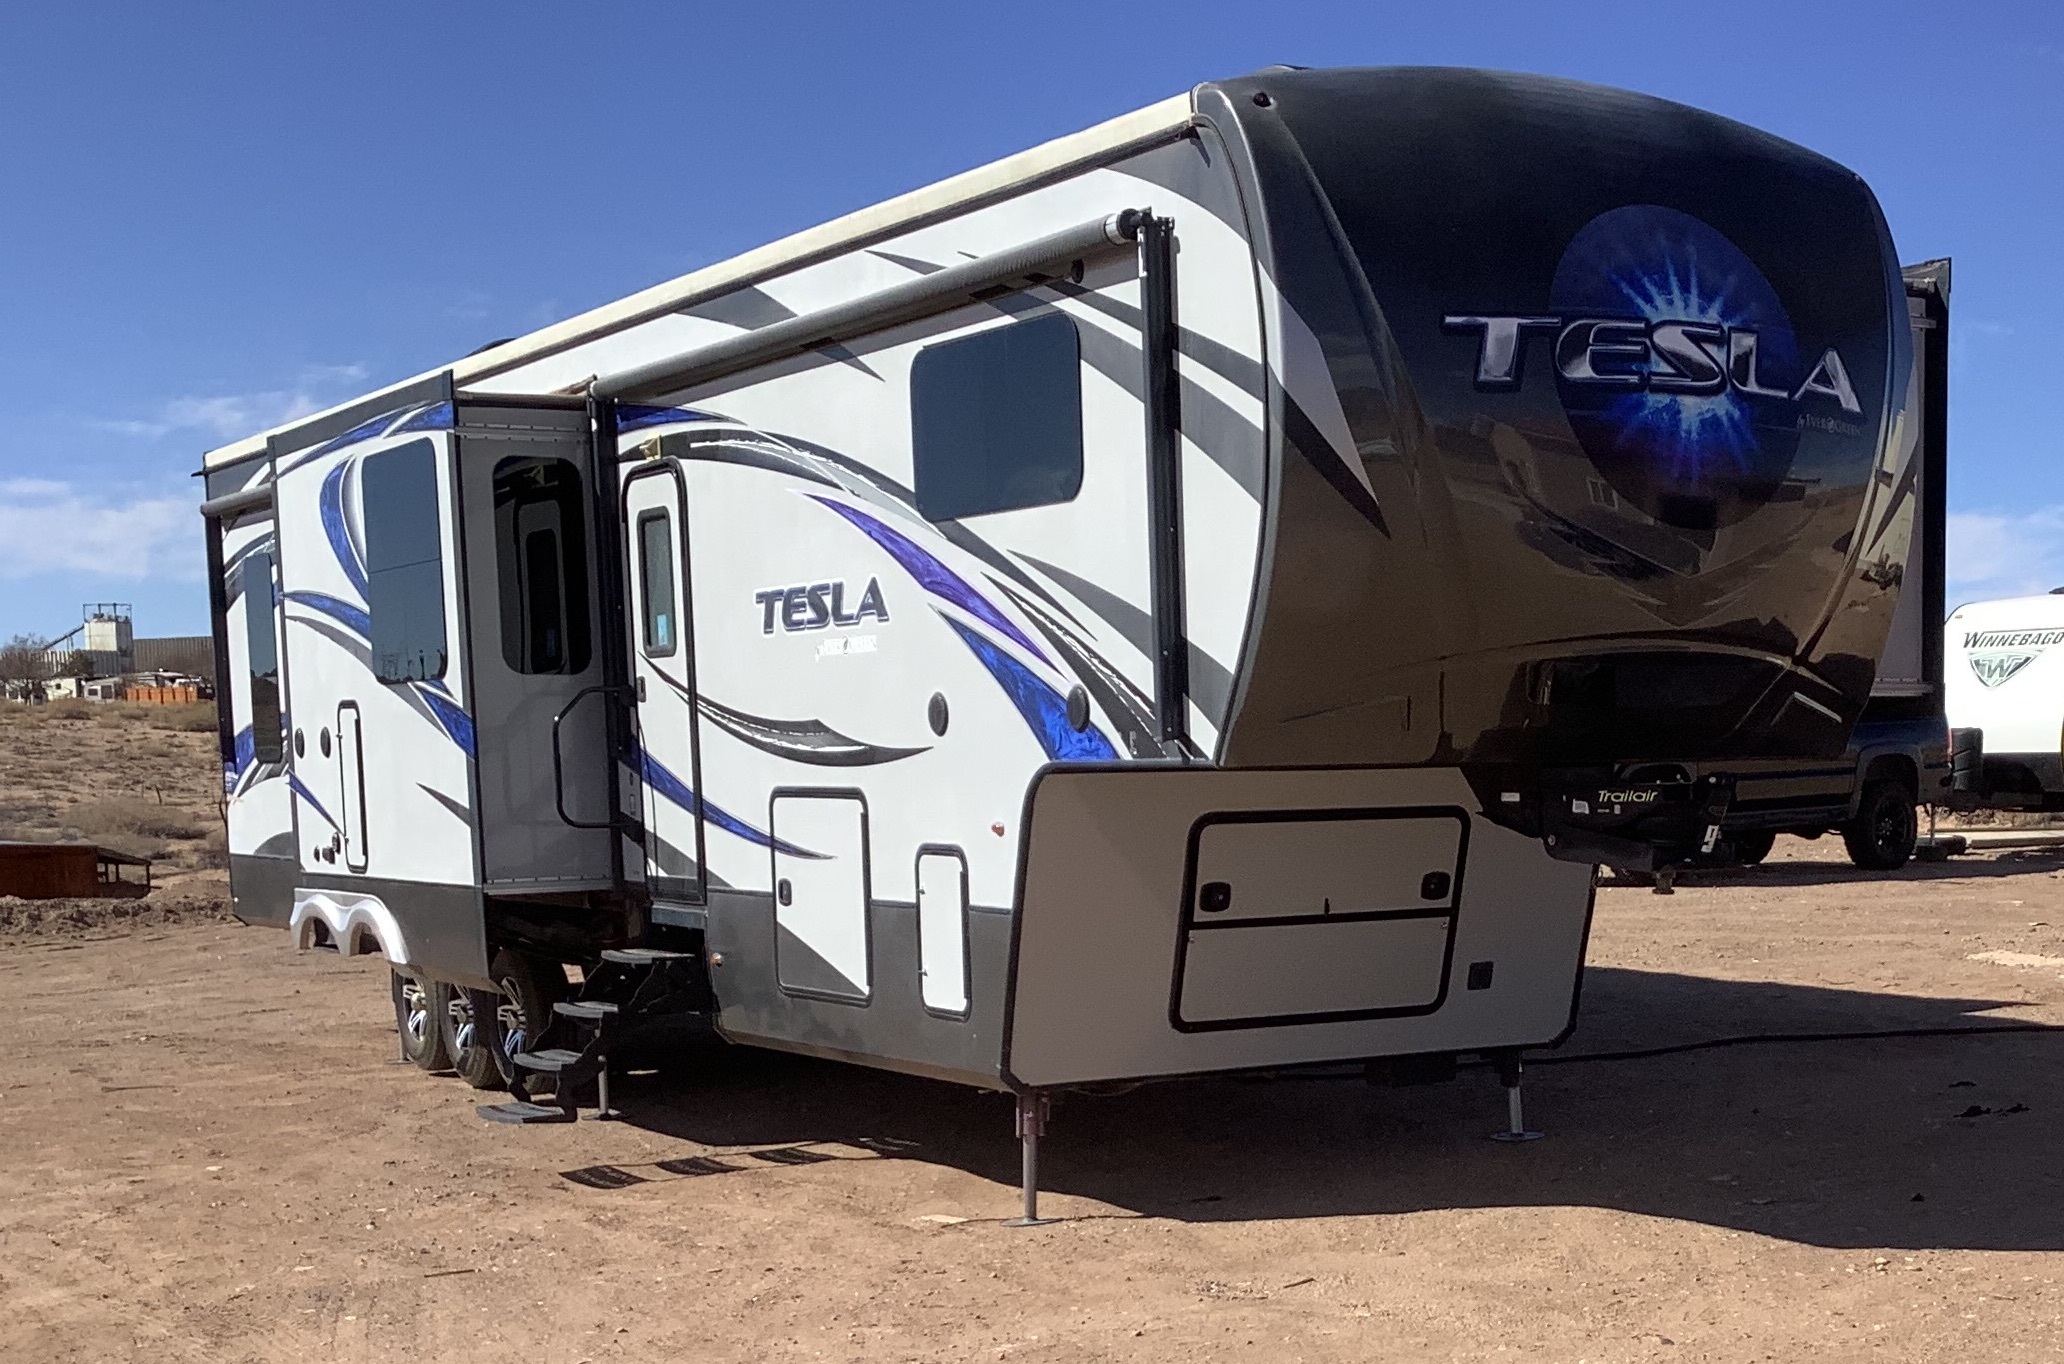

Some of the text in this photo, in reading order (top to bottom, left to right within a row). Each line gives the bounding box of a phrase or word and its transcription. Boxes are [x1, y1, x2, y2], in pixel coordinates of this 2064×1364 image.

[1443, 314, 1863, 415] TESLA
[755, 576, 890, 635] TESLA
[1963, 631, 2064, 648] WINNEBAGO
[1598, 790, 1657, 803] Trailair
